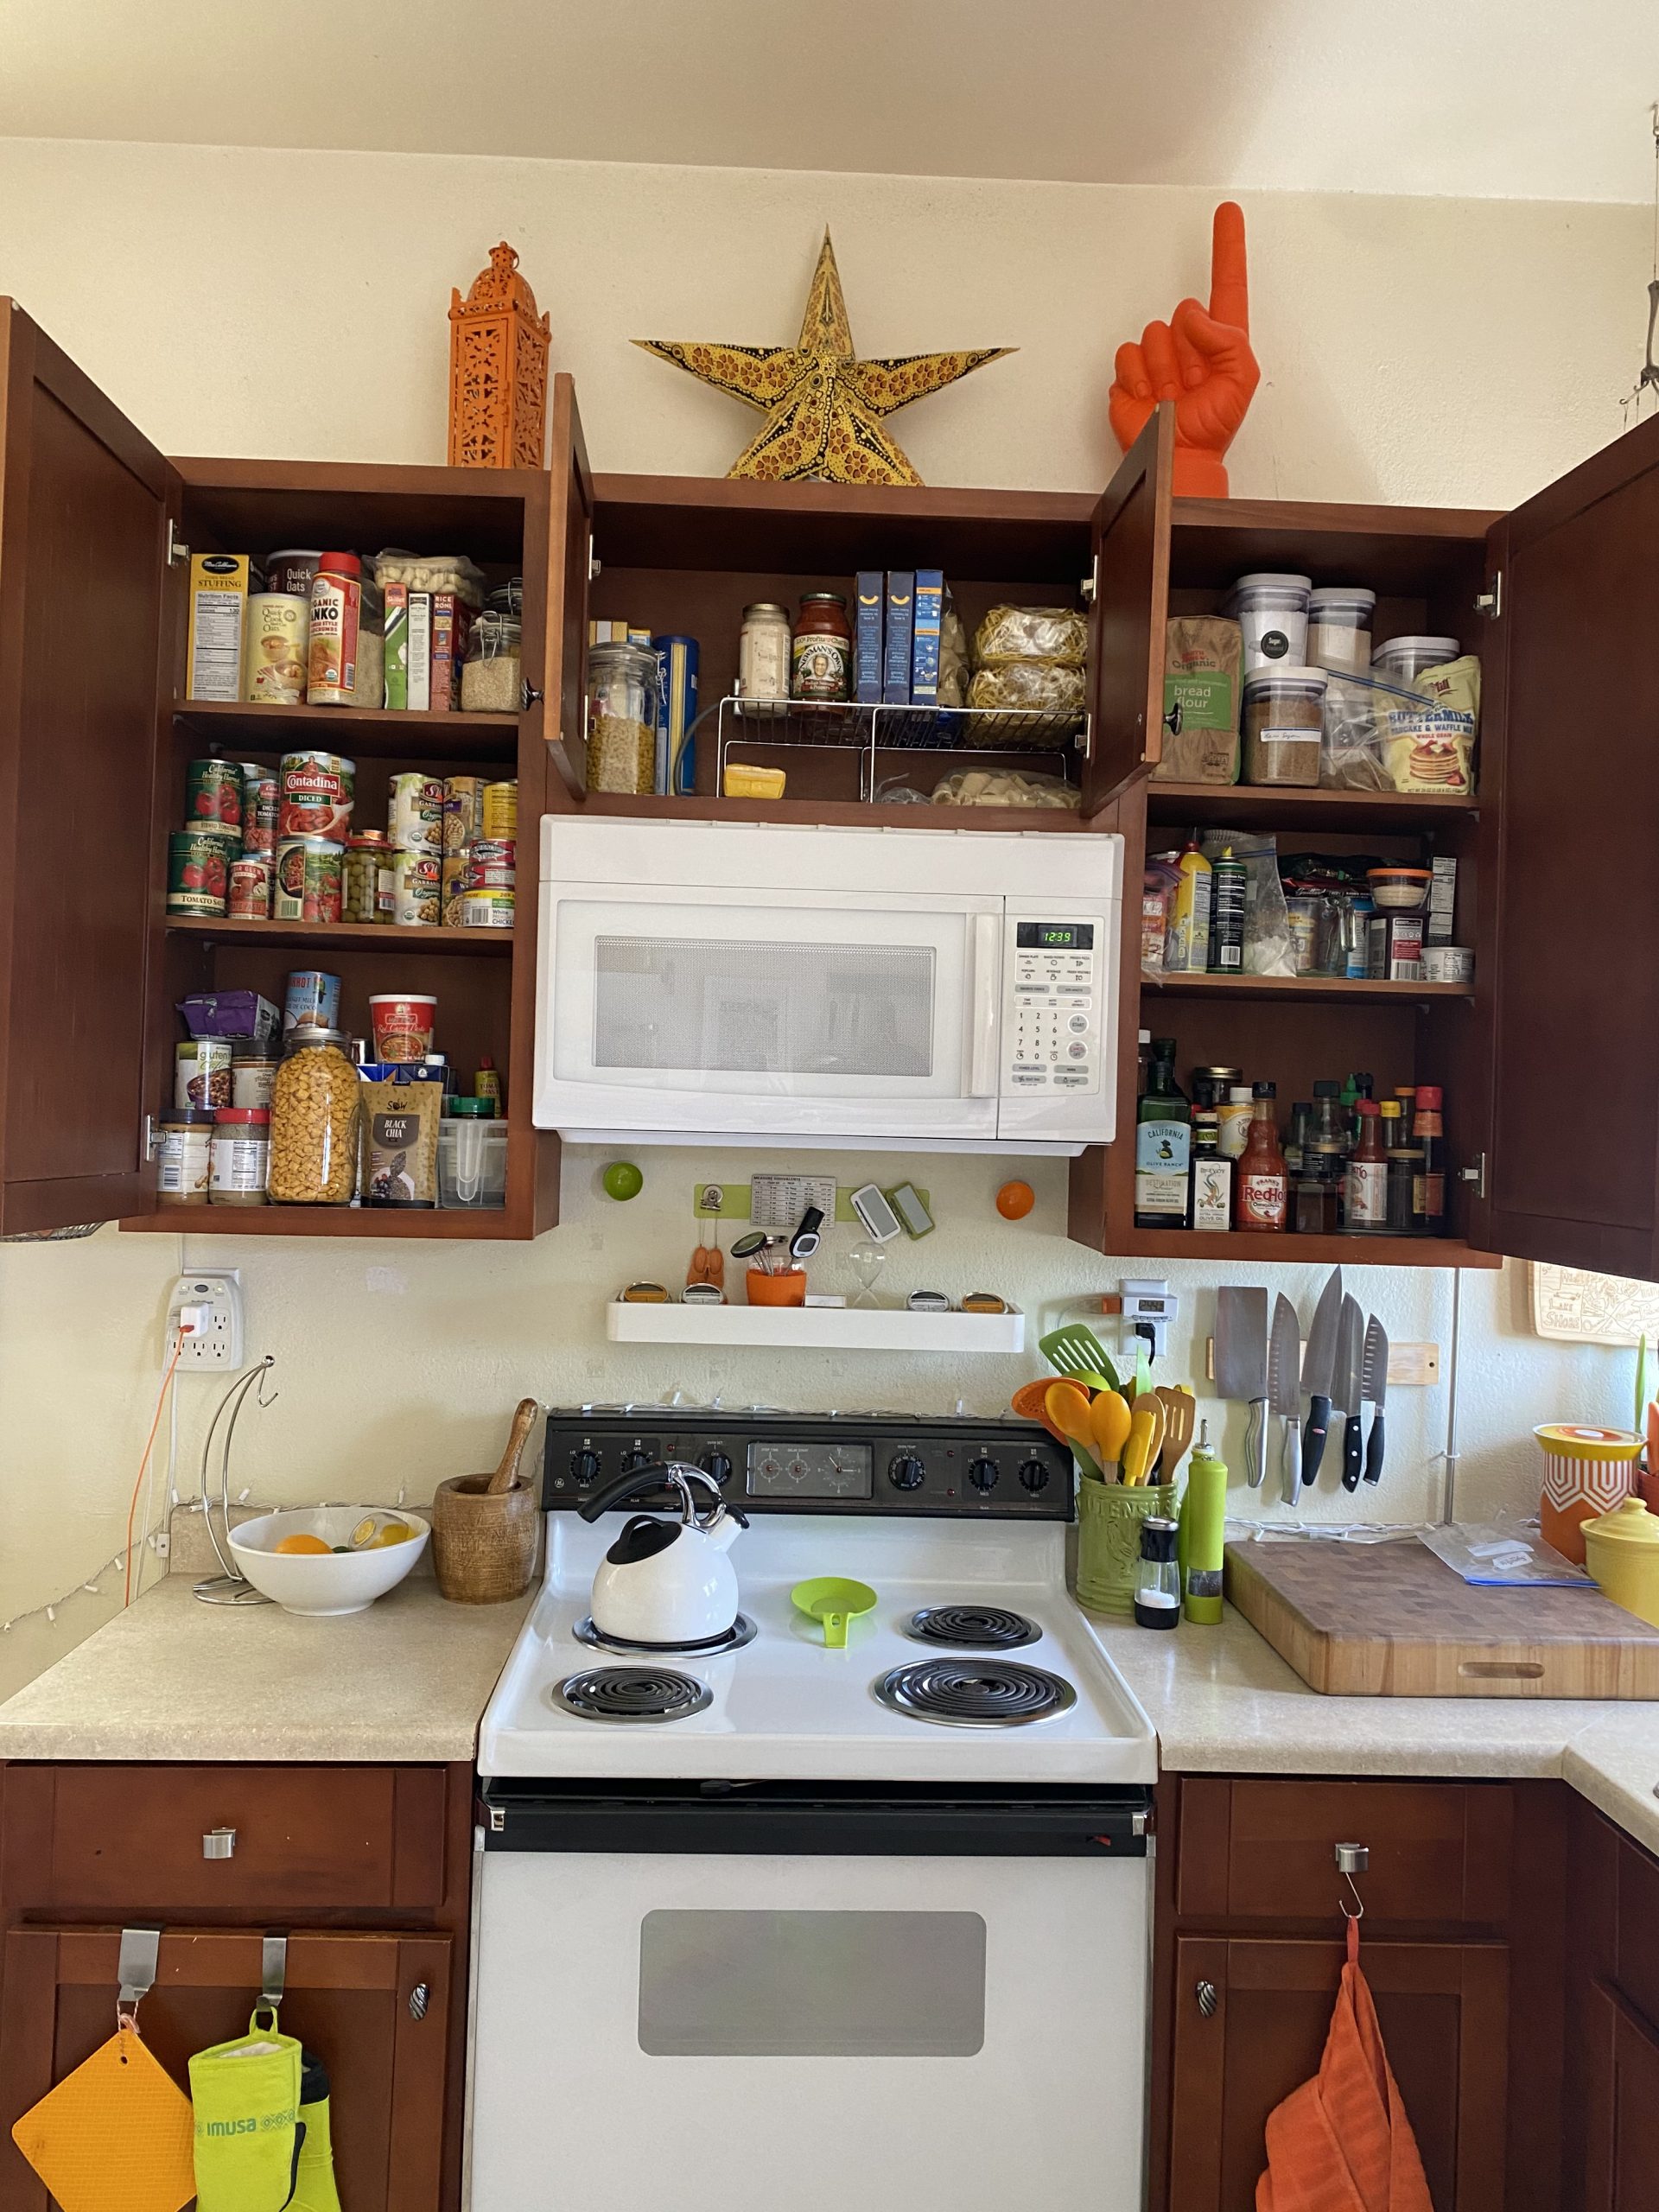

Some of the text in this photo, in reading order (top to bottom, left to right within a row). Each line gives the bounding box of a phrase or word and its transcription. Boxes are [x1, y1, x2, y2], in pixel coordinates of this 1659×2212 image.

[287, 569, 311, 580] Quick
[287, 582, 305, 592] Oats
[311, 607, 338, 620] ANKO
[799, 645, 842, 672] NEWMAN'S OWN
[1172, 659, 1217, 671] Organic
[1174, 685, 1211, 696] bread
[1177, 696, 1208, 708] flour
[287, 775, 338, 790] Contadina
[181, 895, 212, 904] TOMATO
[384, 1120, 407, 1129] BLACK
[385, 1128, 403, 1138] CHIA
[1147, 1128, 1184, 1141] CALIFORNIA
[1544, 1312, 1580, 1329] SHORE
